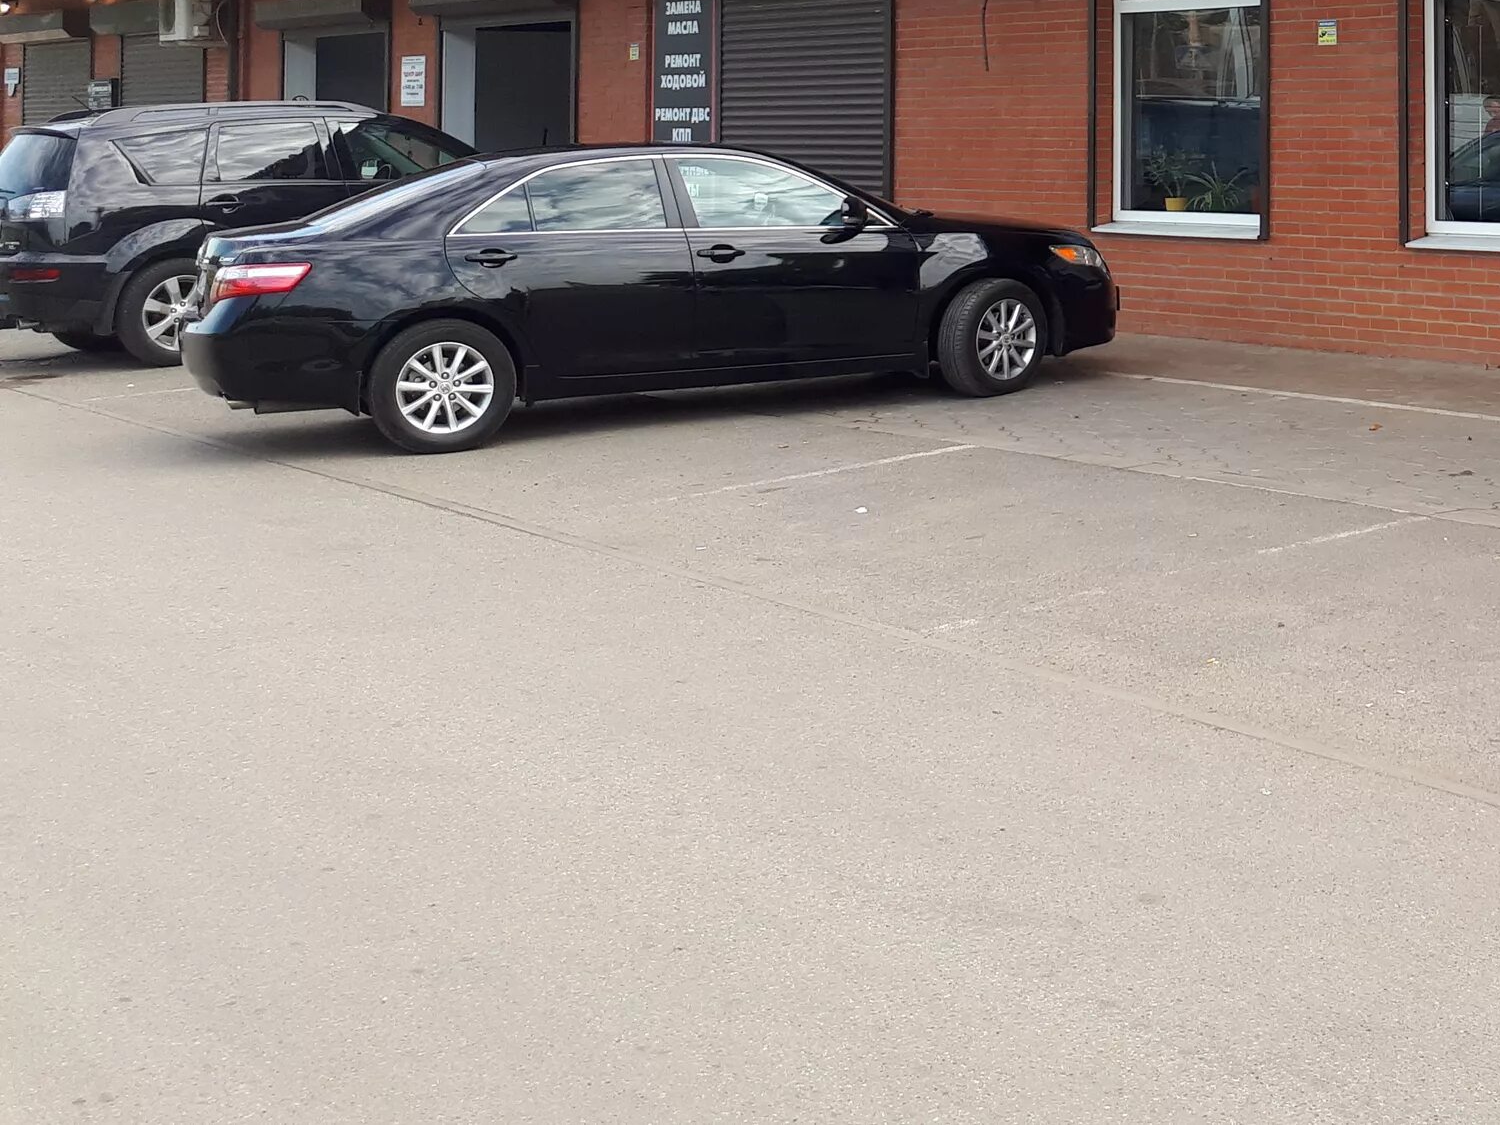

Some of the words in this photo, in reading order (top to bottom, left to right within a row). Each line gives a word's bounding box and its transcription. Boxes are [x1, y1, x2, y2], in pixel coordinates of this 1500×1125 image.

[665, 0, 702, 16] ЗАМЕНА
[667, 20, 699, 35] МАСЛА
[664, 53, 701, 68] РЕМОНТ
[660, 70, 706, 90] ХОДОВОЙ
[655, 107, 691, 122] РЕМОНТ
[691, 107, 710, 123] ДВС
[672, 128, 692, 142] КПП
